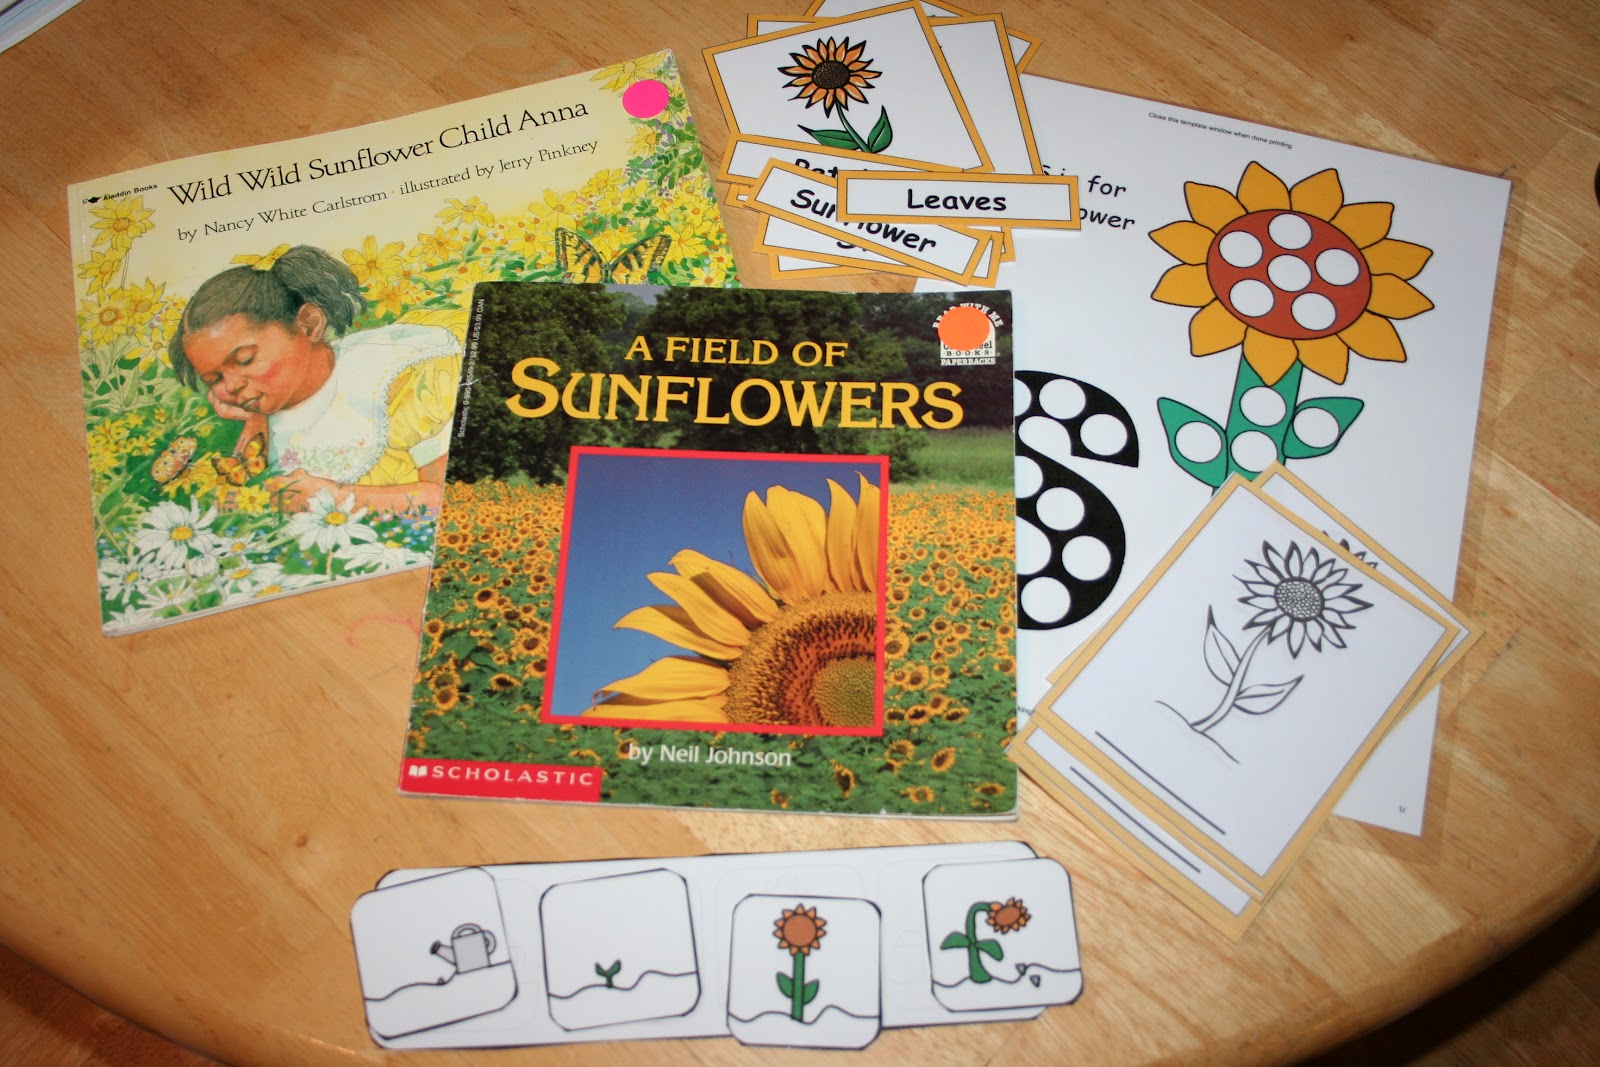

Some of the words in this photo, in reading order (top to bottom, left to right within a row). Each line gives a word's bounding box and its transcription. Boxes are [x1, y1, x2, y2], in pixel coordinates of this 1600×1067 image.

[1148, 112, 1167, 121] Close
[1167, 116, 1179, 124] this
[1180, 119, 1207, 130] template
[1208, 126, 1233, 136] window
[1233, 131, 1251, 139] when
[1251, 135, 1268, 143] done
[1268, 139, 1293, 150] printing
[167, 174, 232, 206] Wild
[237, 162, 301, 192] Wild
[309, 139, 434, 181] Sunflower
[439, 114, 512, 149] Child
[518, 103, 589, 132] Anna
[103, 190, 131, 201] Aladdin
[133, 183, 158, 194] Books
[177, 228, 198, 243] by
[204, 217, 256, 236] Nancy
[257, 208, 309, 224] White
[312, 190, 387, 214] Carlstrom
[400, 167, 471, 195] illustrated
[475, 165, 495, 180] by
[499, 155, 534, 173] Jerry
[538, 140, 599, 163] Pinkney
[1087, 174, 1127, 198] for
[907, 188, 1007, 212] Leaves
[988, 311, 1004, 328] ME
[623, 335, 653, 361] A
[664, 336, 779, 365] FIELD
[791, 340, 849, 368] OF
[940, 358, 996, 366] PAPERBACKS
[457, 406, 469, 438] Scholastic
[476, 298, 485, 313] CAN
[505, 356, 964, 430] SUNFLOWERS
[627, 742, 653, 766] by
[659, 744, 700, 764] Neil
[705, 746, 792, 767] Johnson
[431, 764, 594, 787] SCHOLASTIC
